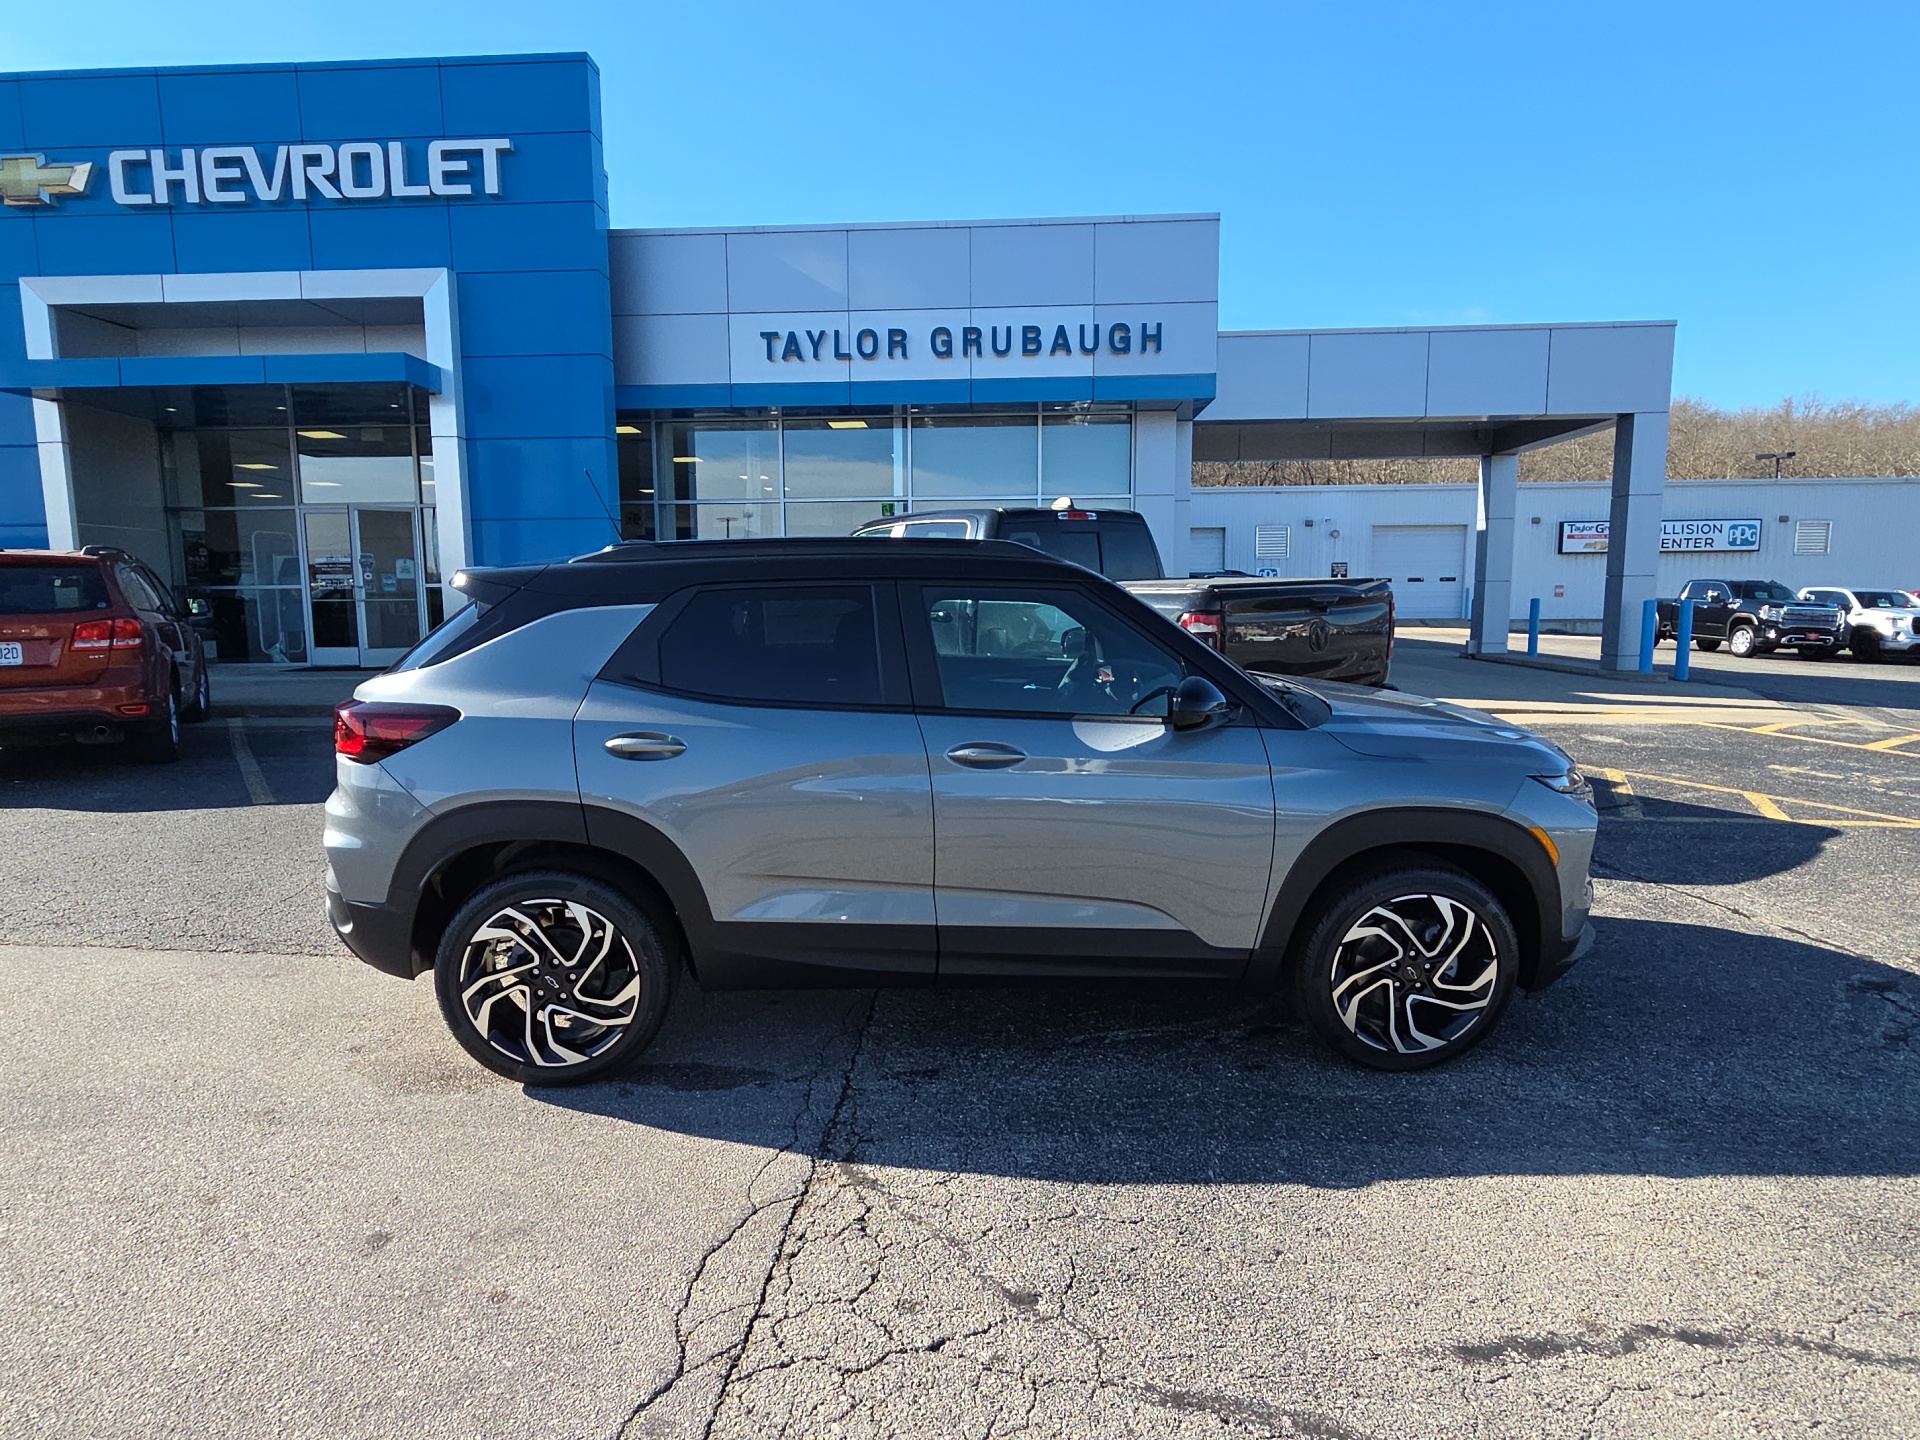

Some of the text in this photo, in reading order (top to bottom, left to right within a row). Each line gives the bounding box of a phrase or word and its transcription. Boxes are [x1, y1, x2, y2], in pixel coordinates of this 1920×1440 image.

[108, 138, 513, 205] CHEVROLET
[760, 322, 1163, 362] TAYLOR GRUBAUGH
[1567, 523, 1594, 534] Taylor
[1660, 523, 1723, 535] LLISION
[1728, 525, 1757, 545] PPG
[1660, 537, 1715, 549] ENTER
